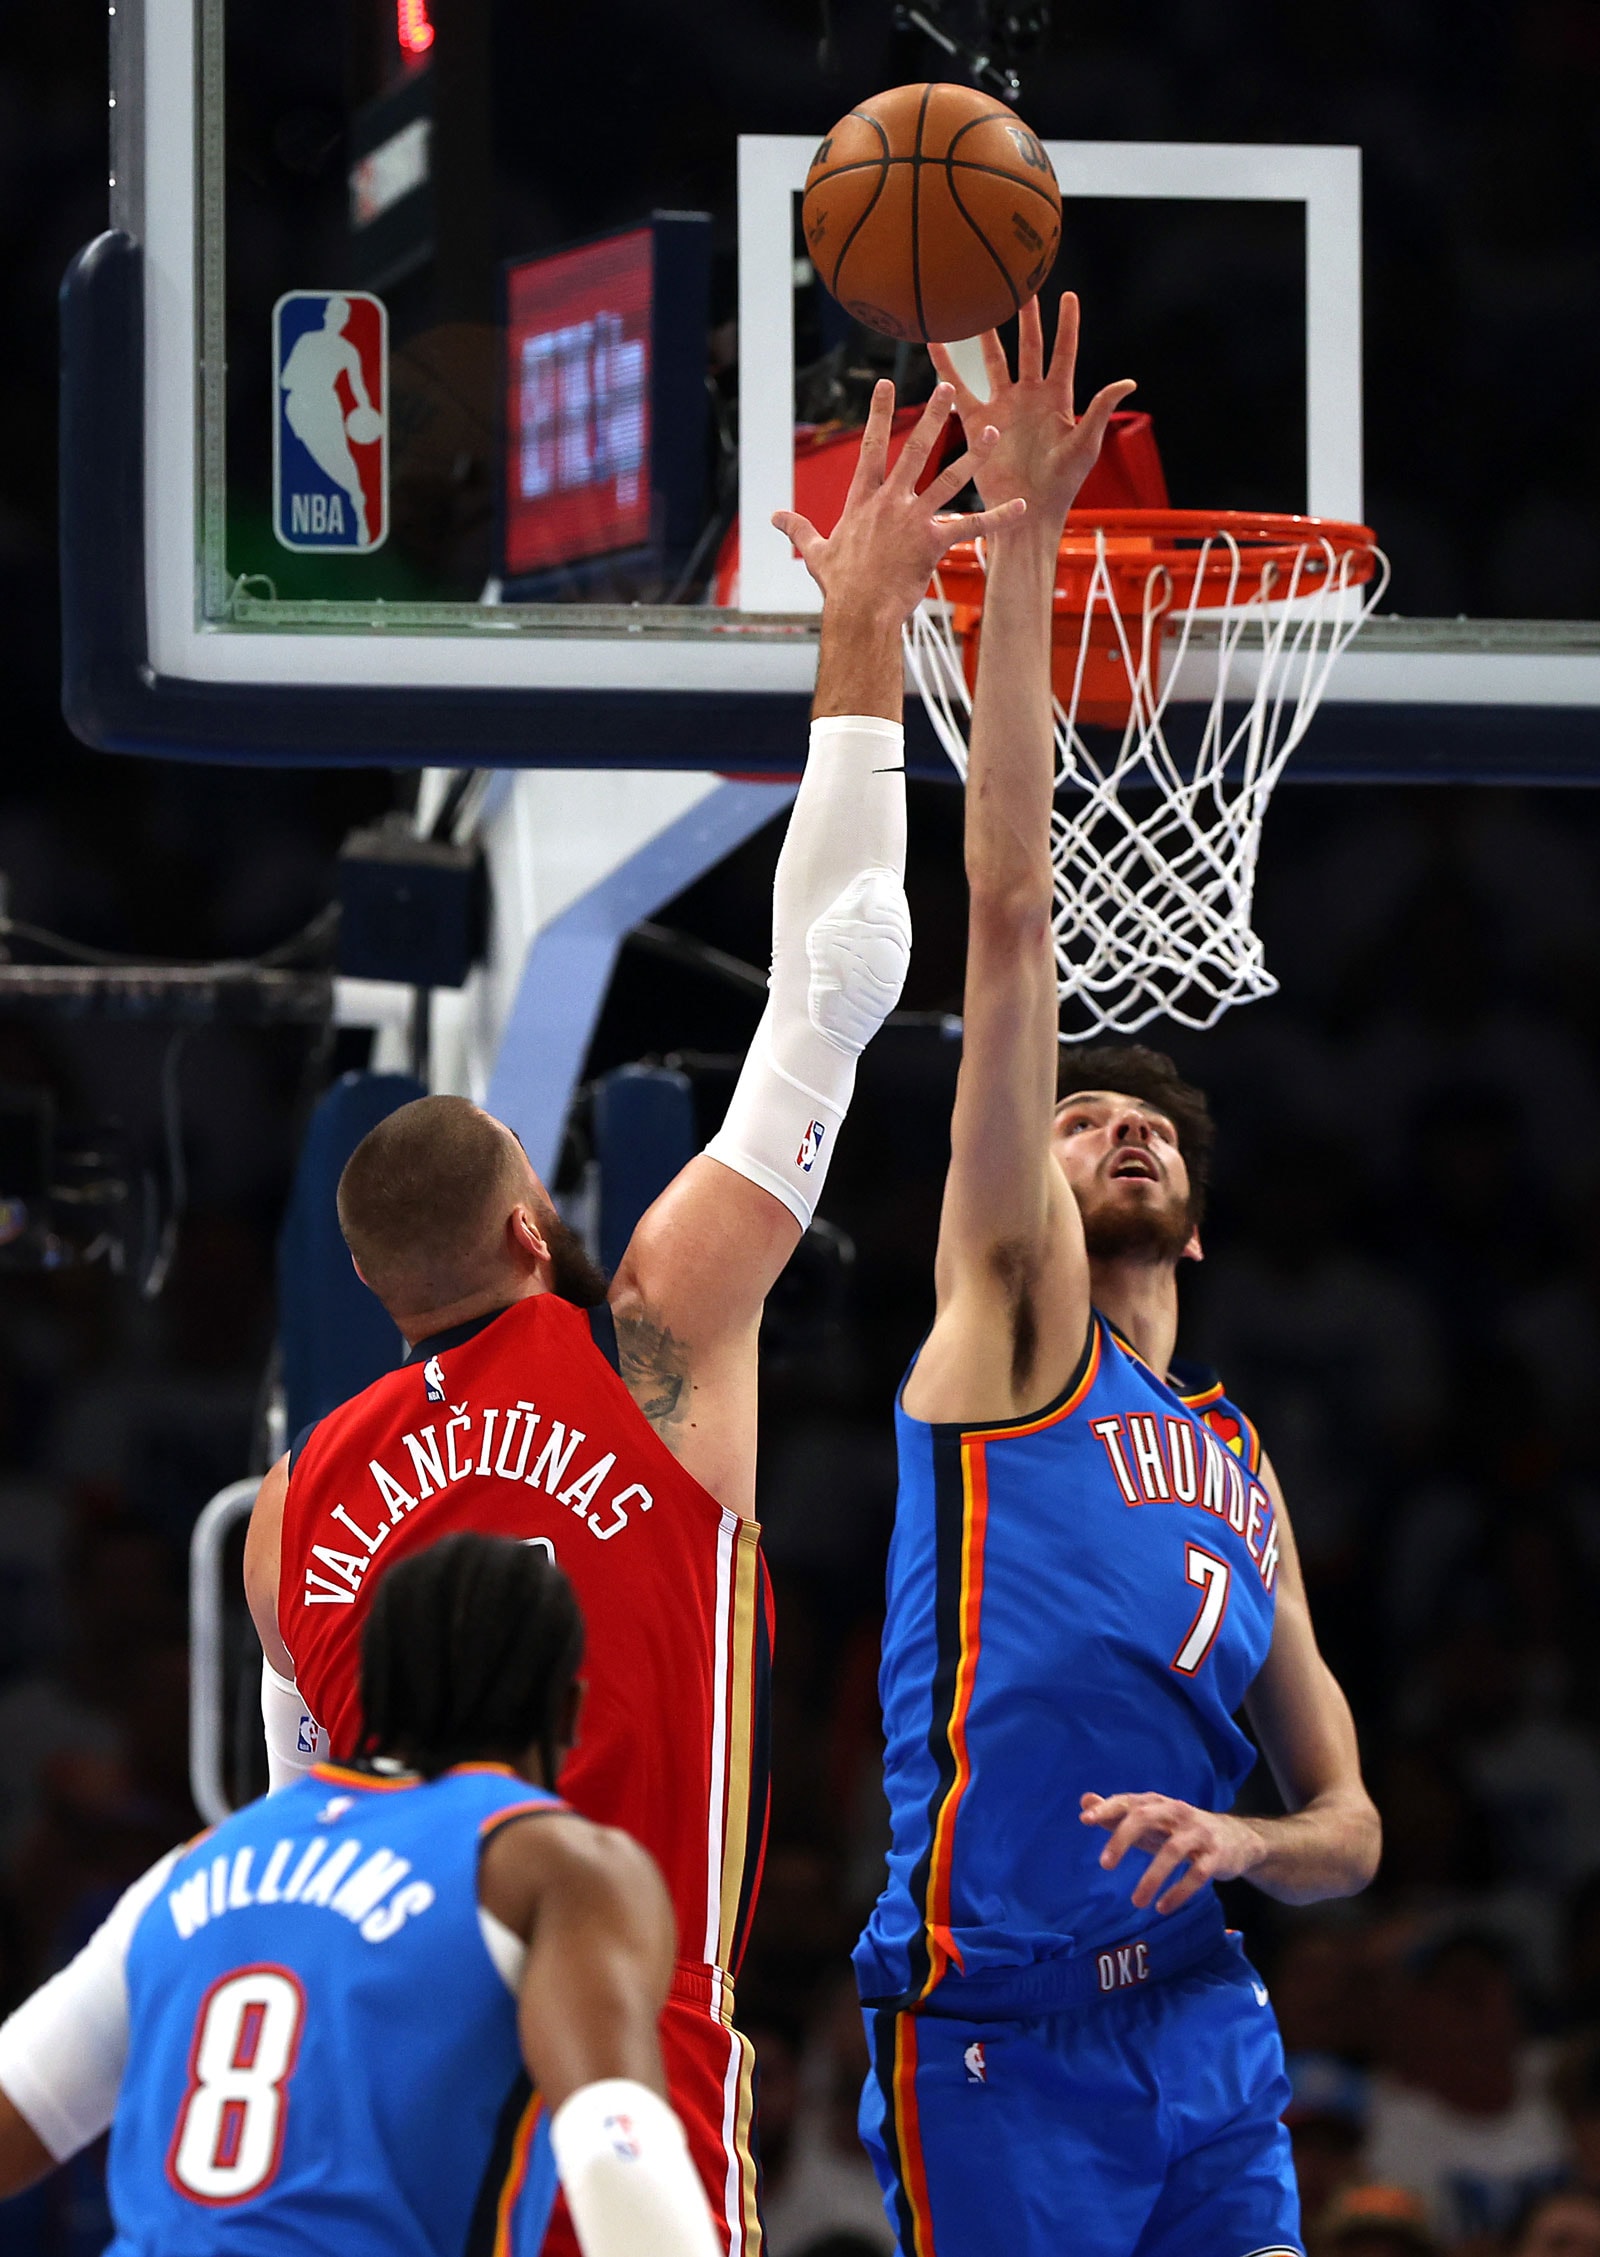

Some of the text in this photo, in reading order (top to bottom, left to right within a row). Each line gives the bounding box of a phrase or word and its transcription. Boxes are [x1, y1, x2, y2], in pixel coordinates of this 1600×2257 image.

[291, 494, 345, 534] NBA
[304, 1400, 654, 1606] VALANČIŪNAS
[1170, 1541, 1231, 1678] 7
[169, 1837, 434, 1943] WILLIAMS
[1098, 1941, 1150, 1992] OKC
[165, 1961, 307, 2208] 8
